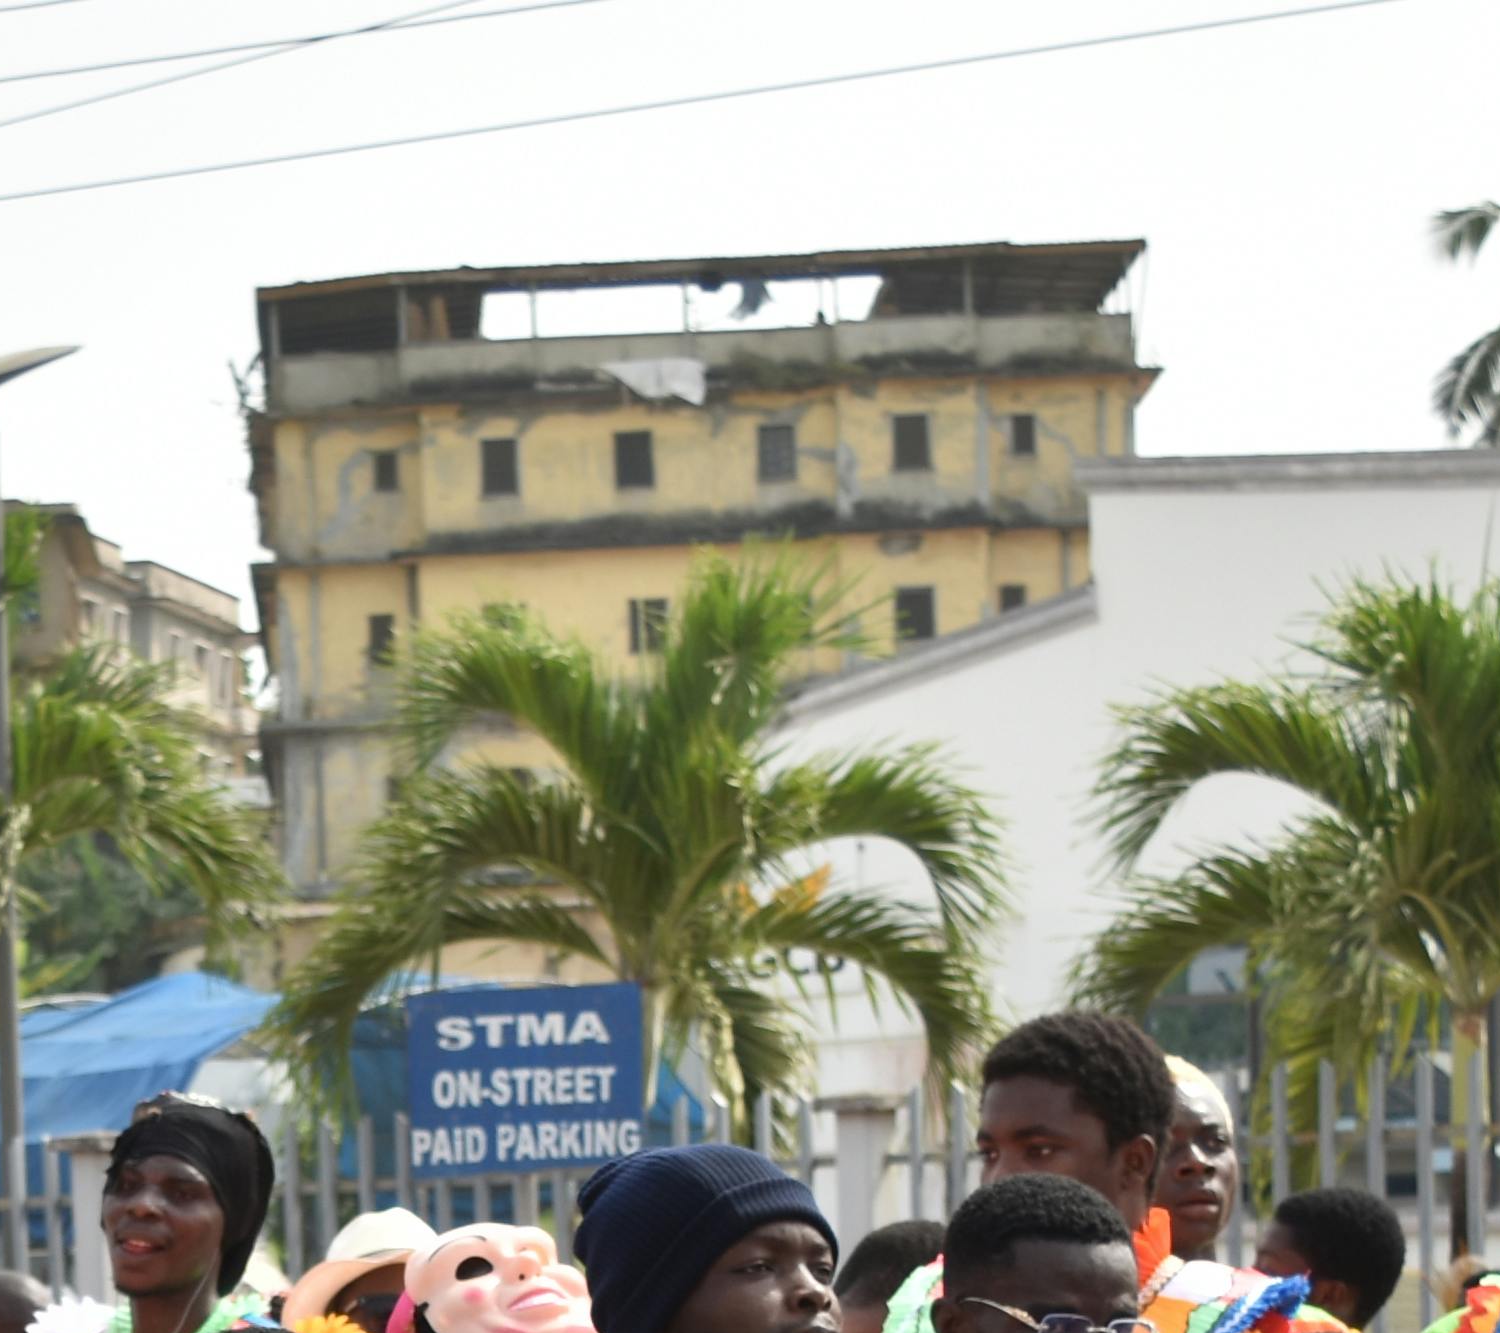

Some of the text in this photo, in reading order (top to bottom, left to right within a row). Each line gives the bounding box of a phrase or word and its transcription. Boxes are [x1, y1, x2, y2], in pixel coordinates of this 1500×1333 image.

[435, 1010, 611, 1052] STMA
[432, 1066, 616, 1109] ON-STREET
[411, 1119, 641, 1167] PAID PARKING
